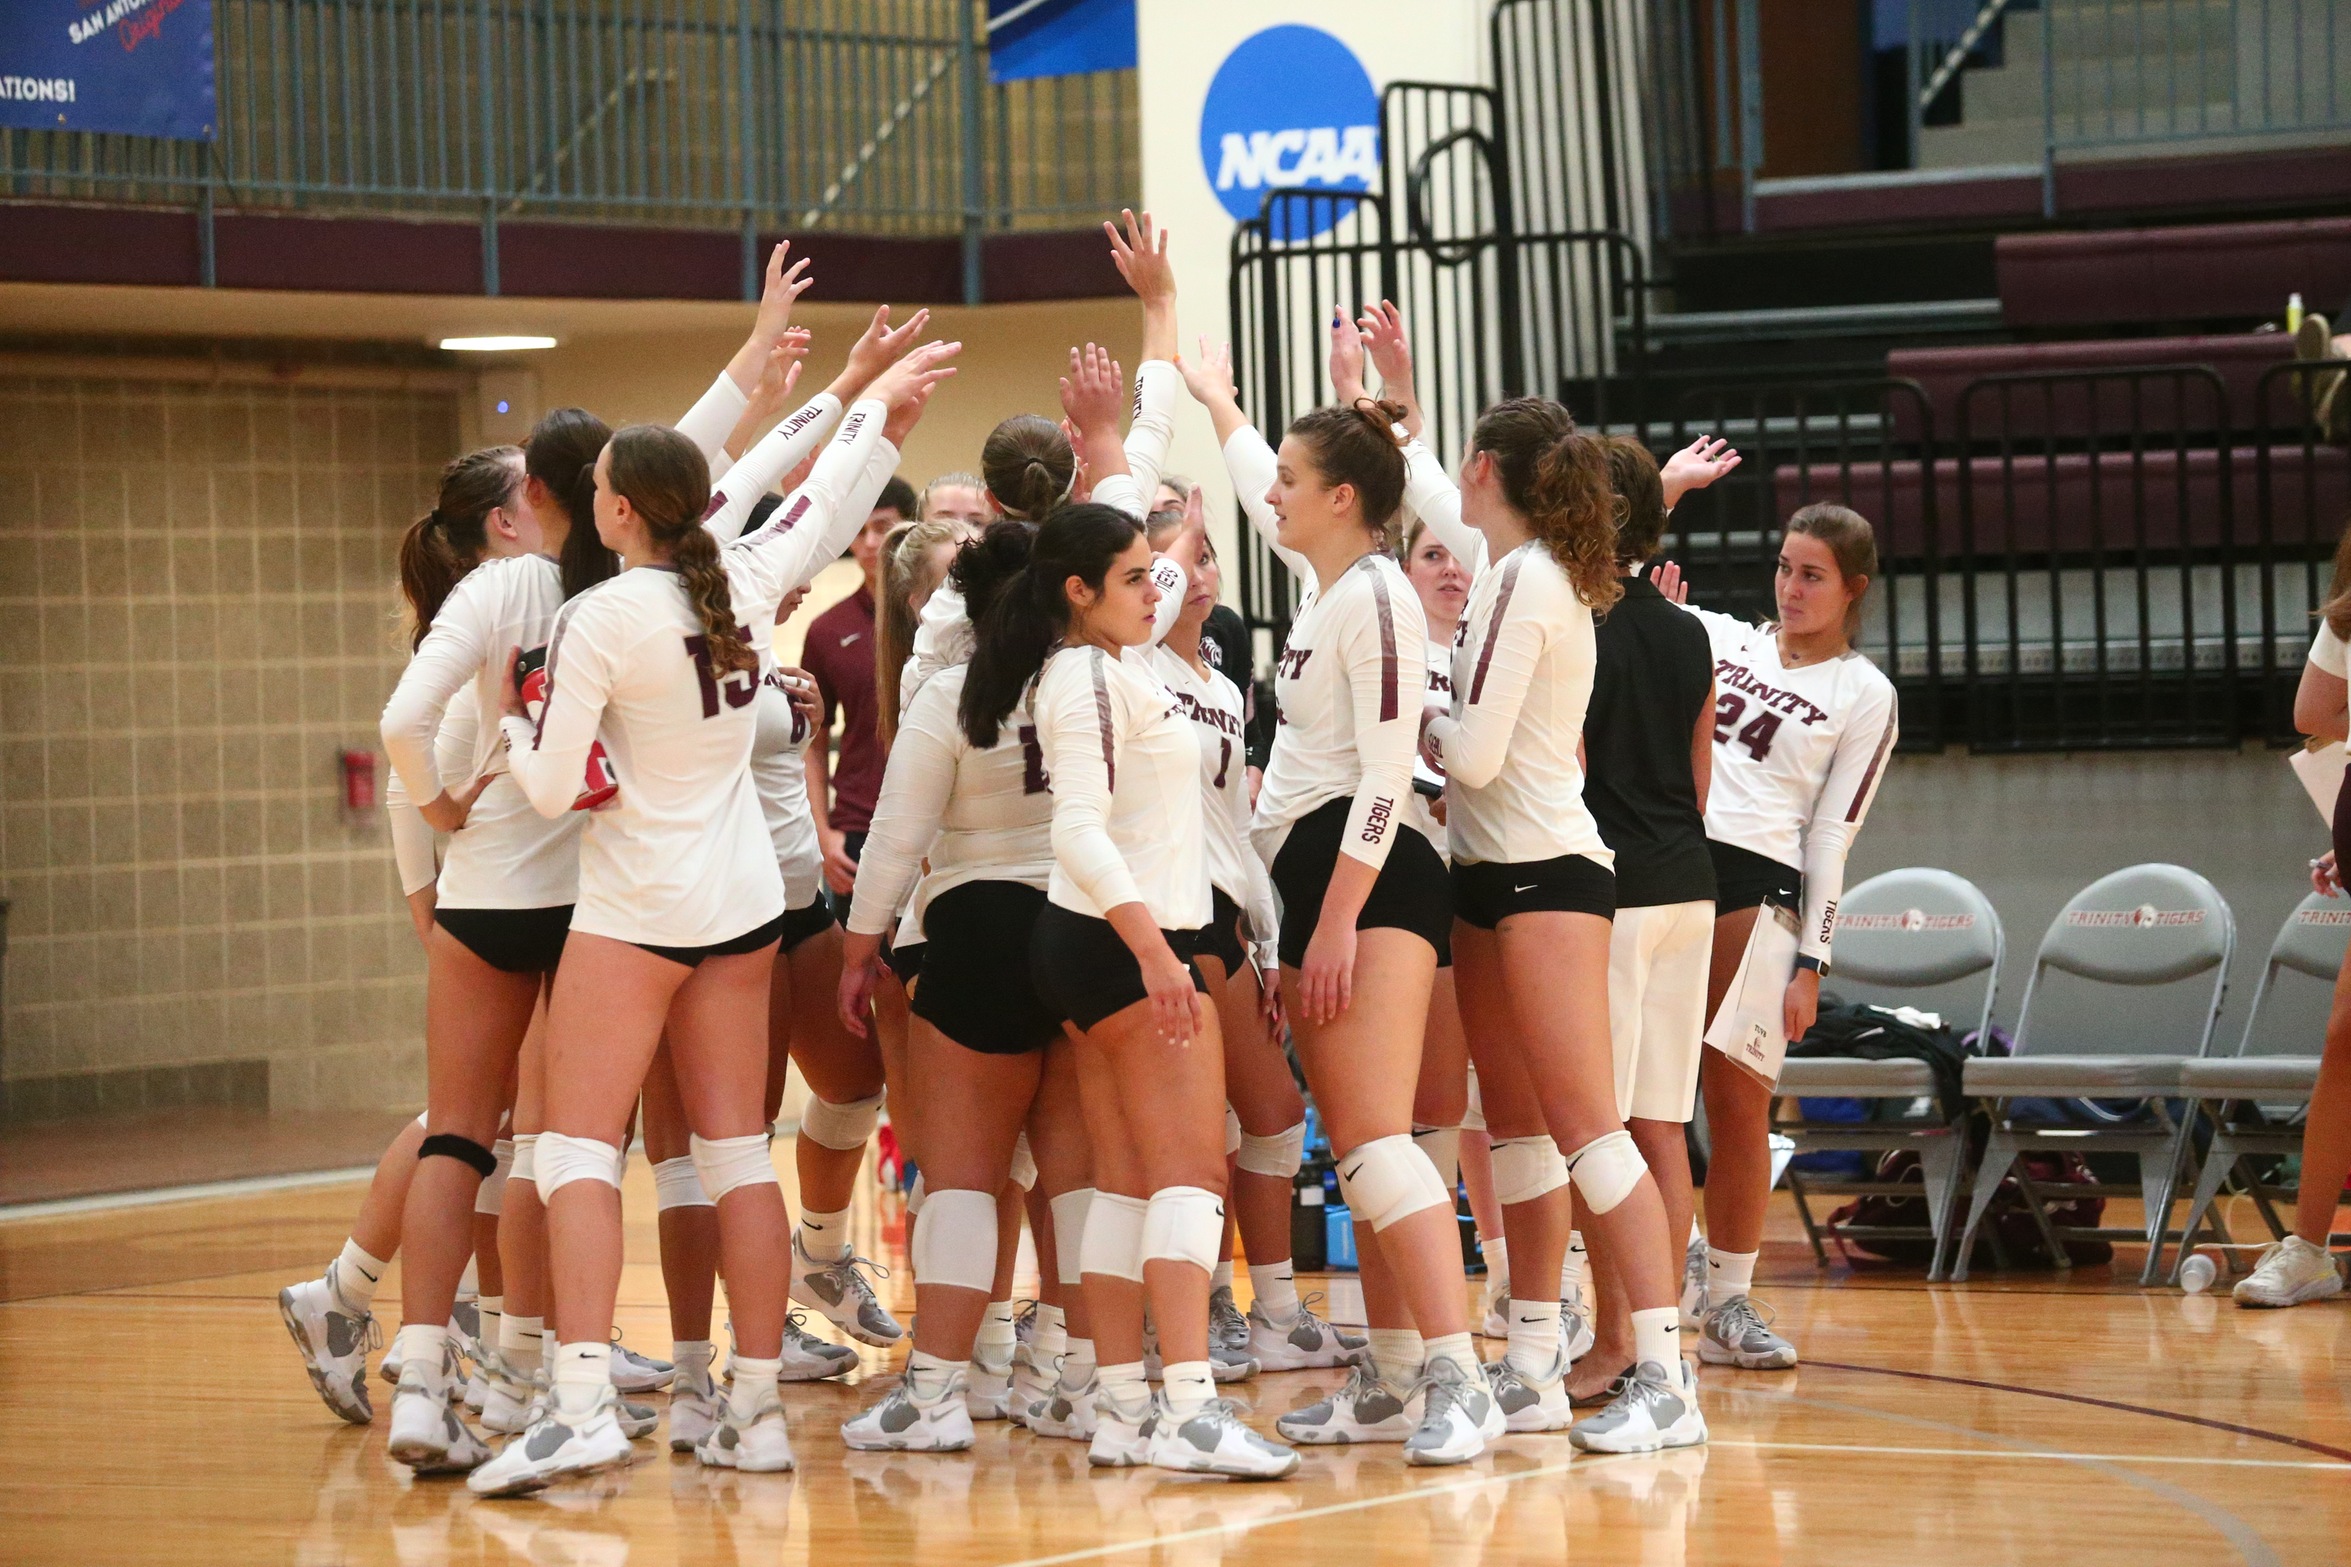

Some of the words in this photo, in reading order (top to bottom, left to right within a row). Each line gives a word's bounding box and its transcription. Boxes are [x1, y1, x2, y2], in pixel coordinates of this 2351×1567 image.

[68, 9, 105, 44] SAN
[1216, 125, 1378, 190] NCAA
[777, 405, 823, 440] TRINITY
[838, 413, 867, 445] TRINITY
[1715, 659, 1828, 726] TRINITY
[1713, 693, 1783, 762] 24
[1361, 796, 1394, 844] TIGERS
[1819, 900, 1838, 944] TIGERS
[1836, 914, 1898, 928] TRINITY
[1925, 914, 1975, 928] TIGERS
[2068, 911, 2133, 925] TRINITY
[2155, 910, 2206, 925] TIGERS
